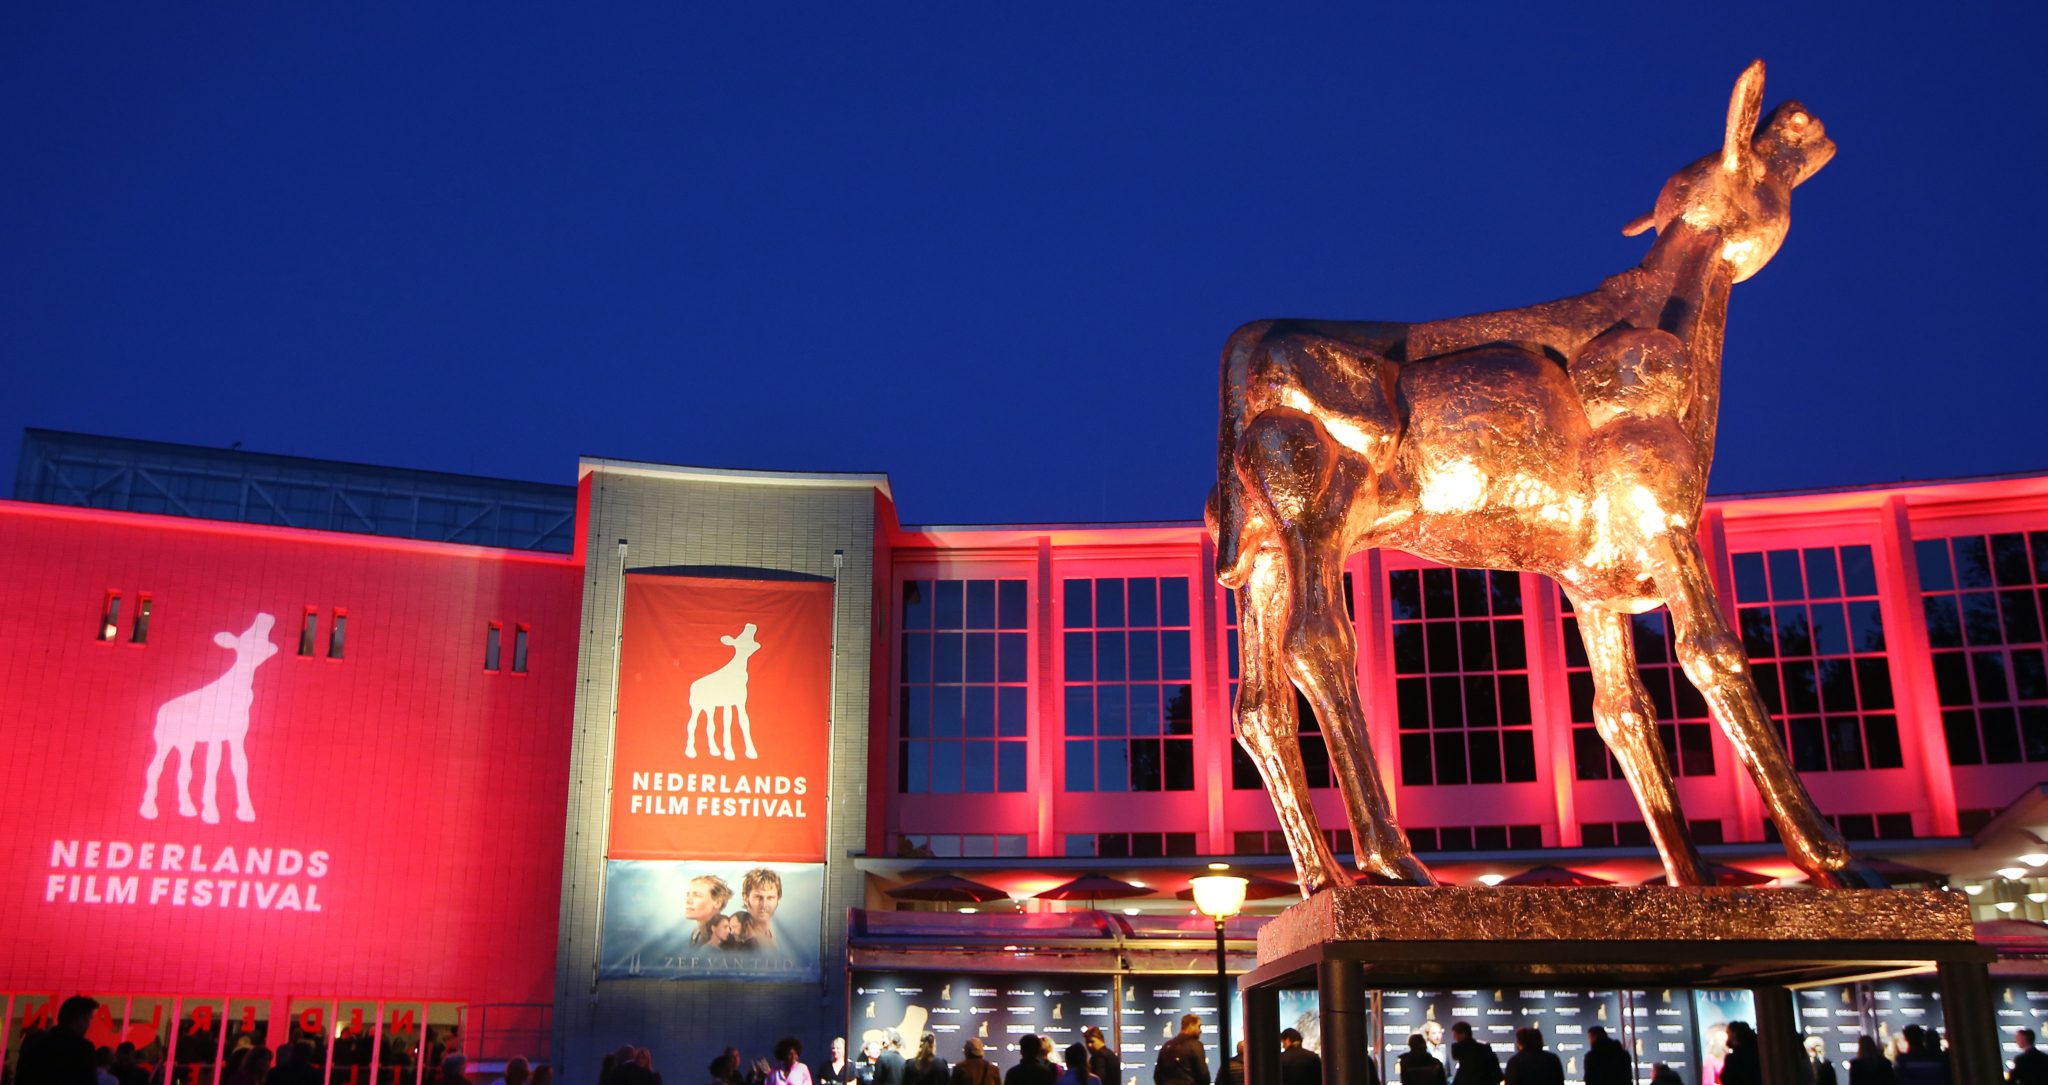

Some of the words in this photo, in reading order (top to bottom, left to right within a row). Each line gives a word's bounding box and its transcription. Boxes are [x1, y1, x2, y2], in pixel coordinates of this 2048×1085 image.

[632, 772, 807, 795] NEDERLANDS
[631, 795, 689, 815] FILM
[696, 797, 807, 818] FESTIVAL
[50, 839, 330, 878] NEDERLANDS
[46, 873, 139, 905] FILM
[150, 876, 322, 912] FESTIVAL
[664, 956, 700, 969] ZEE
[706, 957, 744, 969] VAN
